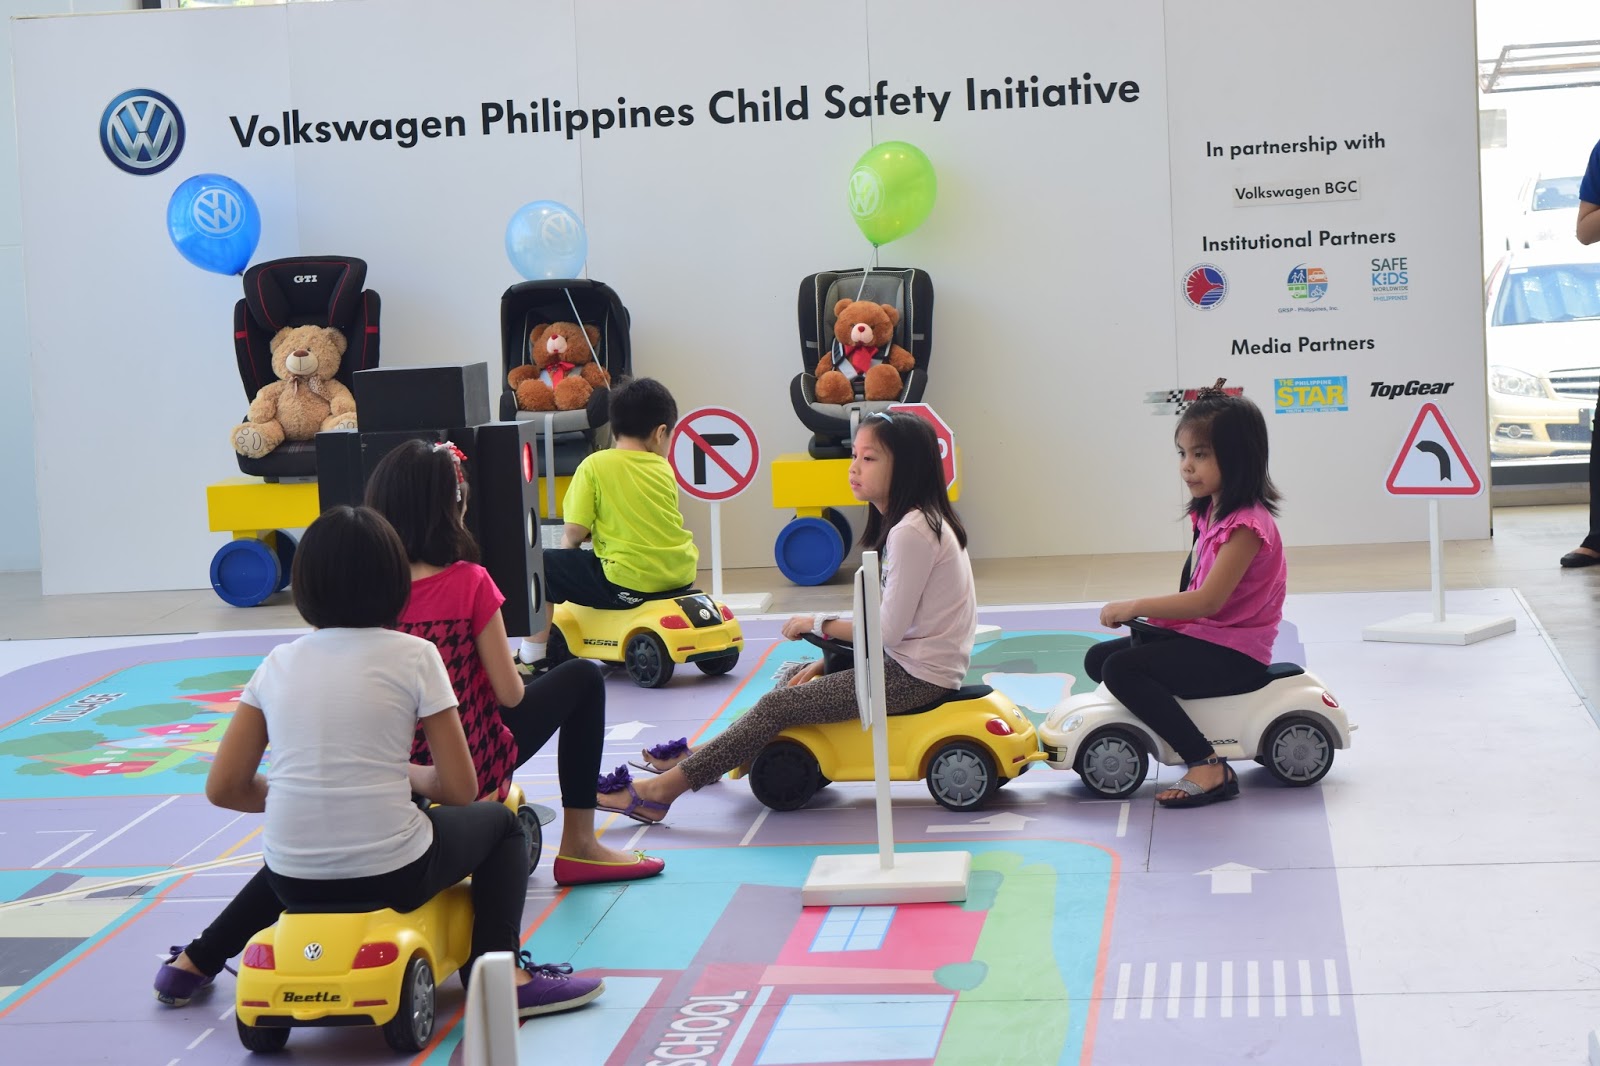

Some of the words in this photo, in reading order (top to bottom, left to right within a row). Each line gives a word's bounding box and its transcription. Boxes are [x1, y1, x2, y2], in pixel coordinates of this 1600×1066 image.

[230, 109, 466, 148] Volkswagen
[482, 96, 694, 139] Philippines
[709, 86, 809, 125] Child
[825, 80, 951, 121] Safety
[967, 73, 1140, 110] Initiative
[1206, 141, 1224, 157] In
[1230, 136, 1338, 160] partnership
[1344, 132, 1386, 150] with
[1235, 185, 1321, 200] Volkswagen
[1325, 181, 1358, 195] BGC
[1202, 231, 1312, 252] Institutional
[1319, 230, 1396, 247] Partners
[1371, 257, 1408, 272] SAFE
[293, 274, 318, 283] GTI
[1373, 294, 1408, 302] PHILIPPINES
[1231, 338, 1292, 356] Media
[1298, 337, 1375, 353] Partners
[1277, 385, 1345, 407] STAR
[30, 692, 127, 725] VILLAGE
[283, 991, 341, 1003] Beetle
[644, 990, 750, 1066] SCHOOL
